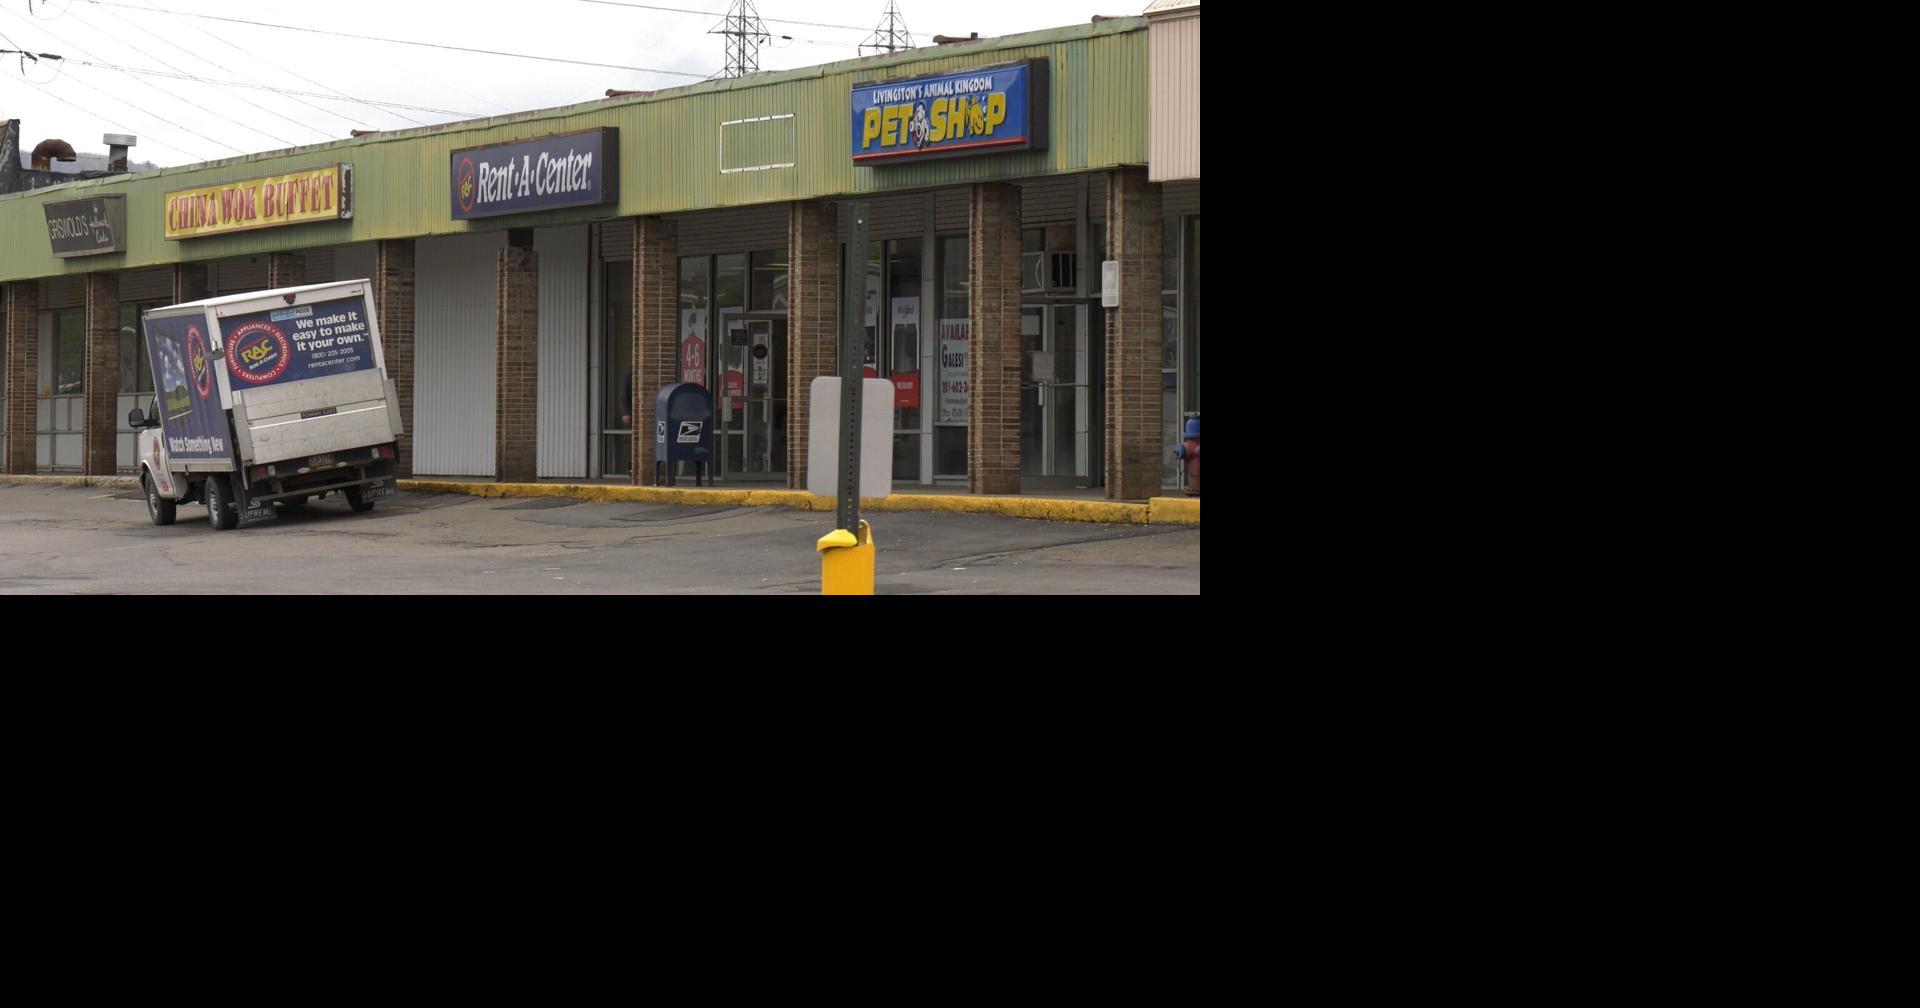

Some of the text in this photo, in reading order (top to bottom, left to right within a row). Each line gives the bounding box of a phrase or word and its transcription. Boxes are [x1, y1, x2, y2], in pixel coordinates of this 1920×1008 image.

[873, 76, 993, 104] LIVINGSTON'S ANIMAL KINGDOM
[862, 103, 914, 149] PET
[168, 174, 333, 231] CHINA WOK BUFFET
[237, 323, 271, 336] APPLIANCES
[292, 321, 365, 342] easy to make
[296, 318, 314, 329] We
[316, 313, 346, 327] make
[347, 311, 358, 321] it
[228, 339, 239, 370] FURNITURE
[240, 339, 273, 363] RAC
[275, 332, 288, 367] ELECTRONICS
[296, 341, 307, 352] it
[308, 338, 334, 351] your
[686, 343, 700, 367] 4-6
[242, 370, 276, 380] COMPUTERS
[168, 435, 224, 454] Watch Something New
